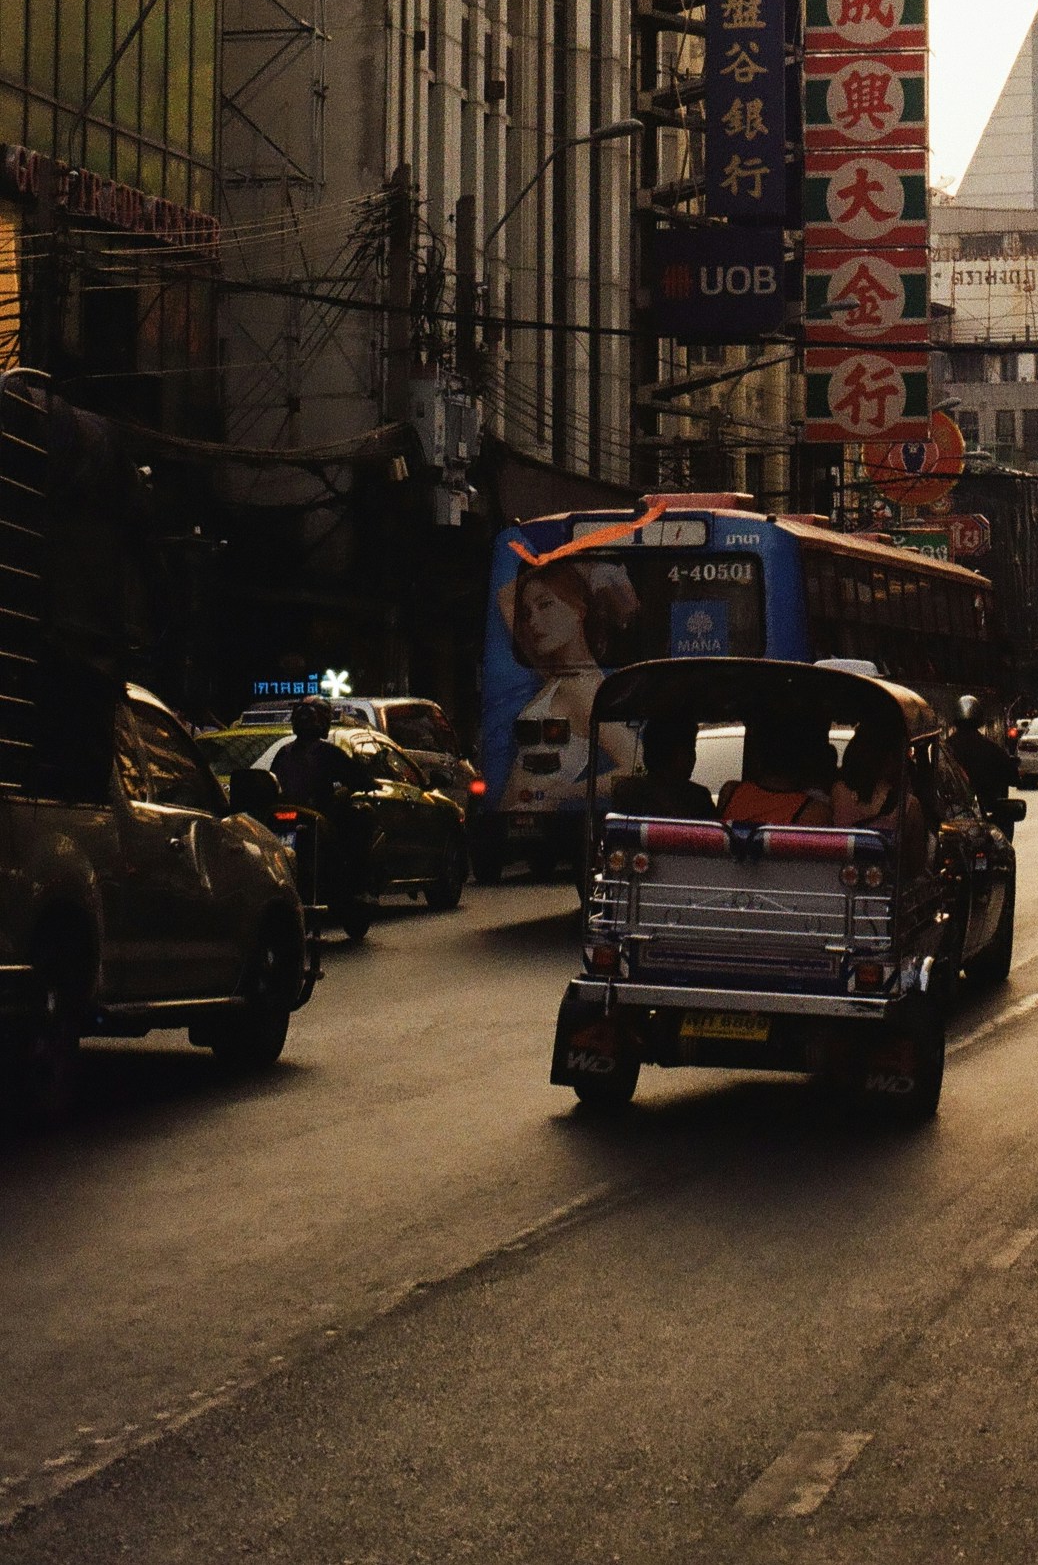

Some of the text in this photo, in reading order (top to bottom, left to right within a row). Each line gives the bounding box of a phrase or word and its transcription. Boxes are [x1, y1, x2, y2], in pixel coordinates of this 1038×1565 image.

[701, 264, 777, 296] UOB
[667, 563, 754, 582] 4-40501
[677, 639, 721, 653] MANA
